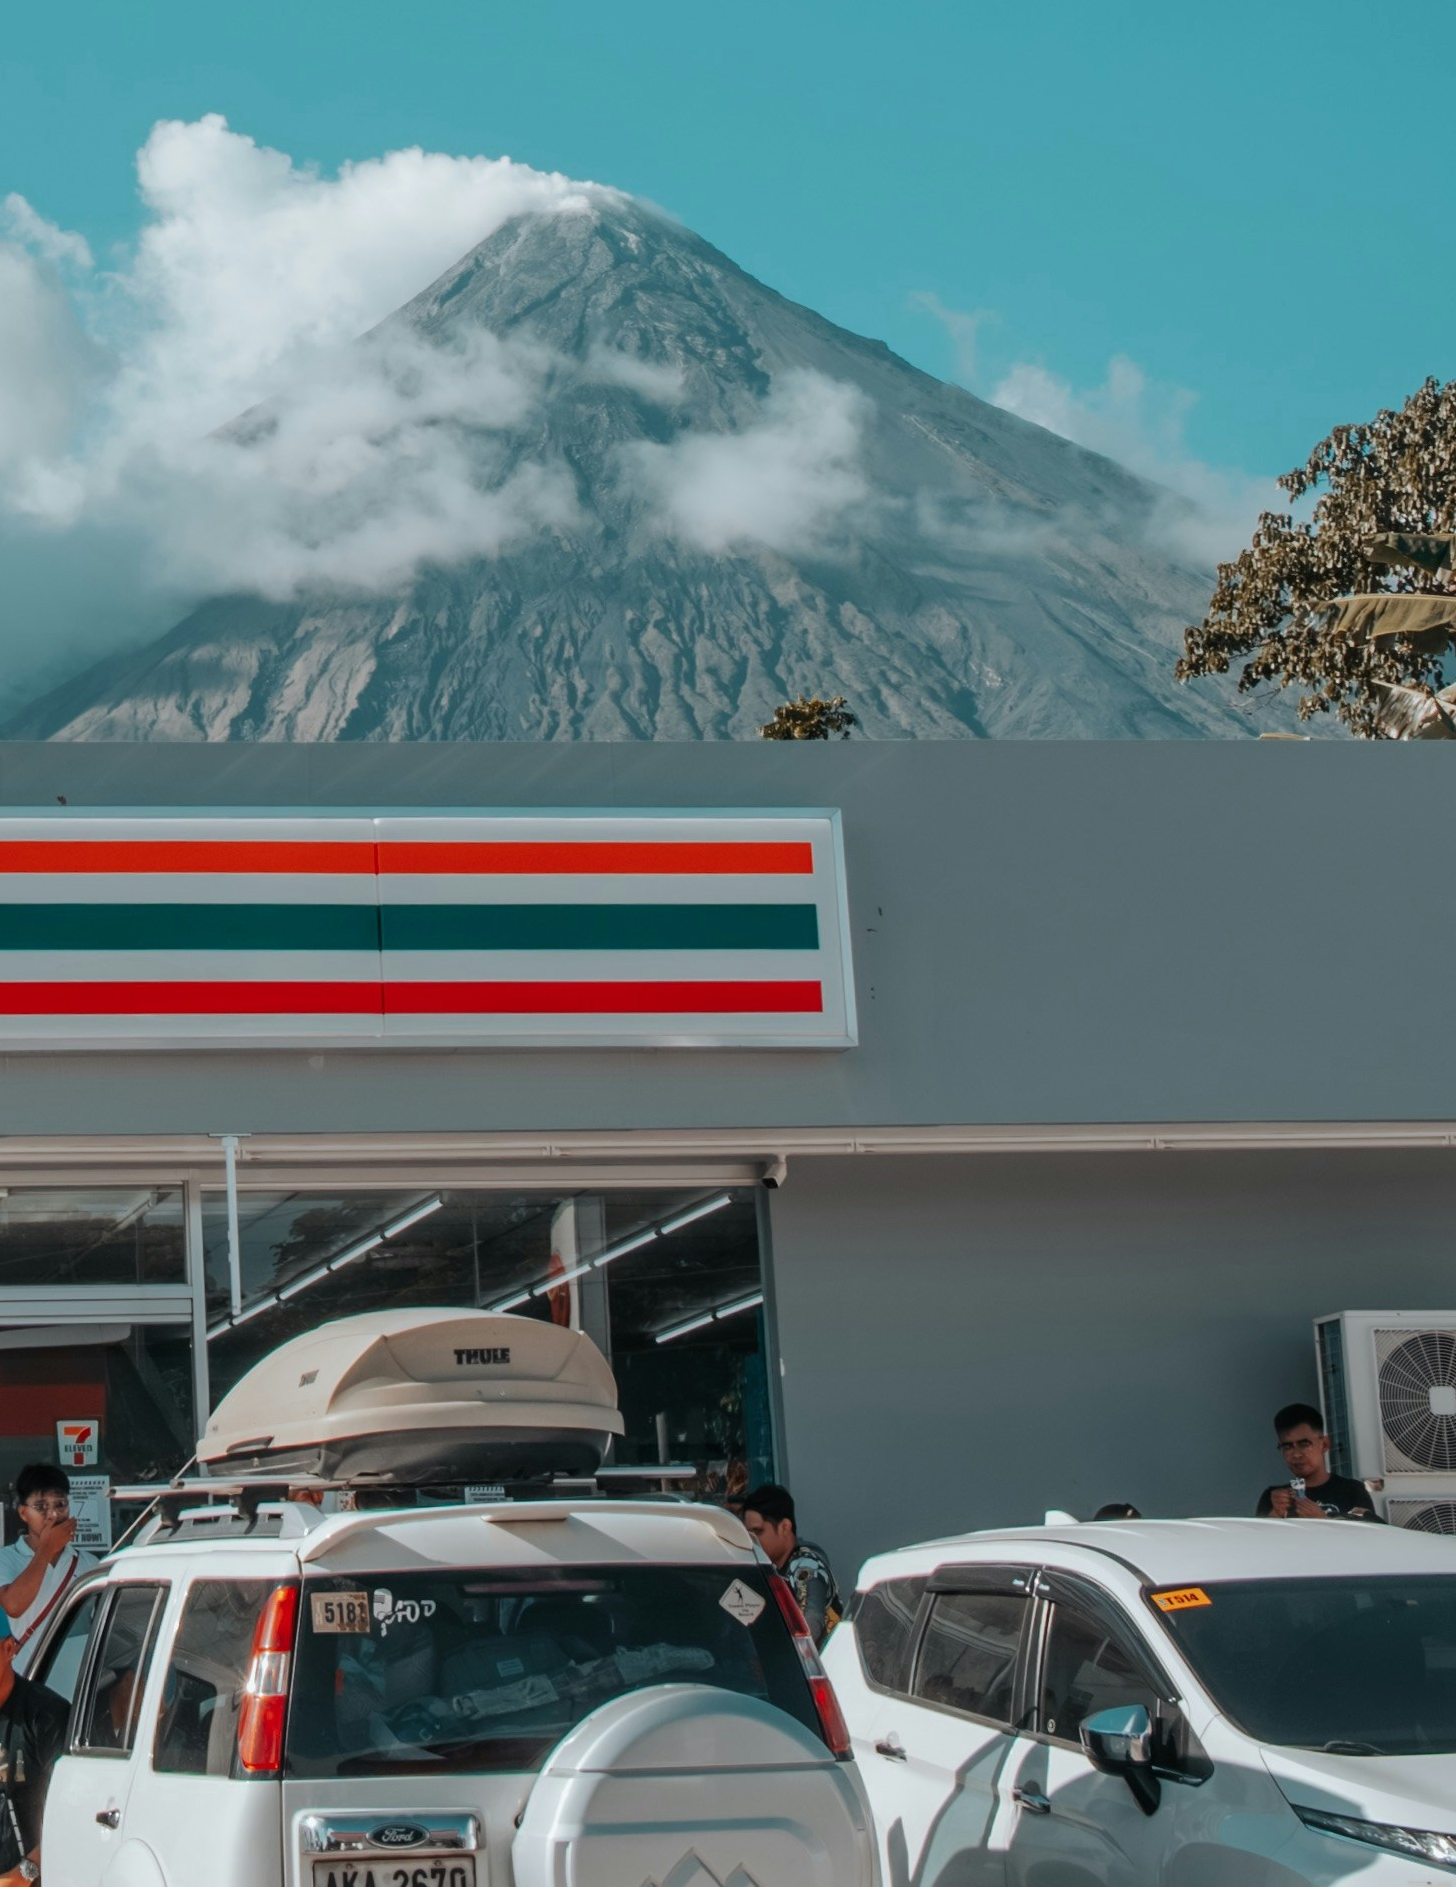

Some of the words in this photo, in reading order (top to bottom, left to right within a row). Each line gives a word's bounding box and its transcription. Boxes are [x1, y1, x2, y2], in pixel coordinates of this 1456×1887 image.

[453, 1347, 510, 1365] THULE
[64, 1427, 91, 1464] 7
[381, 1828, 414, 1843] Ford
